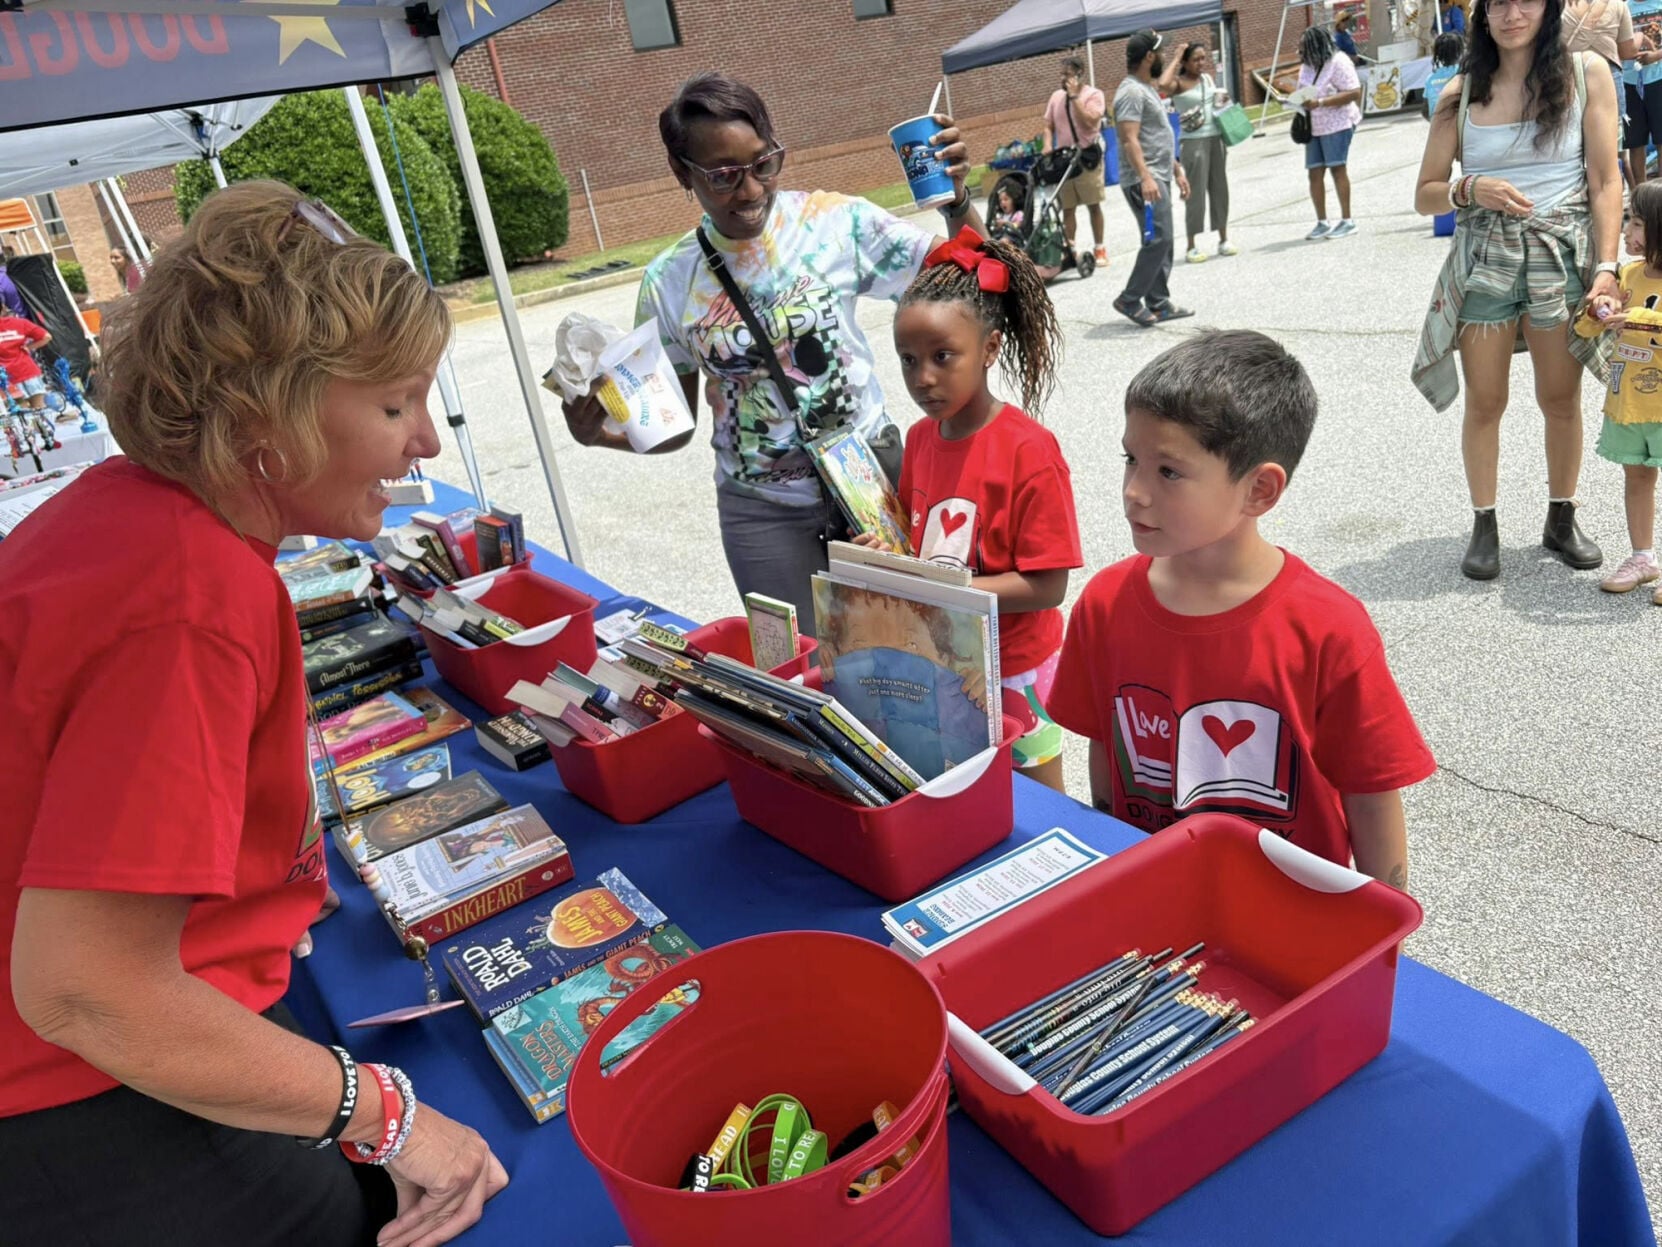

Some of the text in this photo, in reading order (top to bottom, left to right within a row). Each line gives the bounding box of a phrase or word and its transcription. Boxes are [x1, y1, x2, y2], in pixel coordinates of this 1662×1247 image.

[319, 659, 371, 687] Almost There
[1127, 696, 1172, 740] Love
[442, 877, 527, 933] INKHEART
[556, 904, 605, 945] JAMES
[462, 945, 500, 993] ROALD
[490, 936, 533, 985] DAHL
[1029, 1031, 1063, 1058] Douglas
[1061, 1013, 1092, 1038] County
[1088, 997, 1117, 1021] School
[1114, 981, 1145, 1006] System
[340, 1051, 354, 1067] TO
[519, 1029, 563, 1082] DRAGON
[1090, 1057, 1123, 1083] County
[1119, 1040, 1150, 1064] School
[1146, 1022, 1181, 1050] System
[343, 1068, 358, 1108] LOVE
[711, 1125, 738, 1168] READ
[774, 1136, 787, 1145] I
[789, 1150, 806, 1170] TO
[698, 1155, 712, 1174] TO
